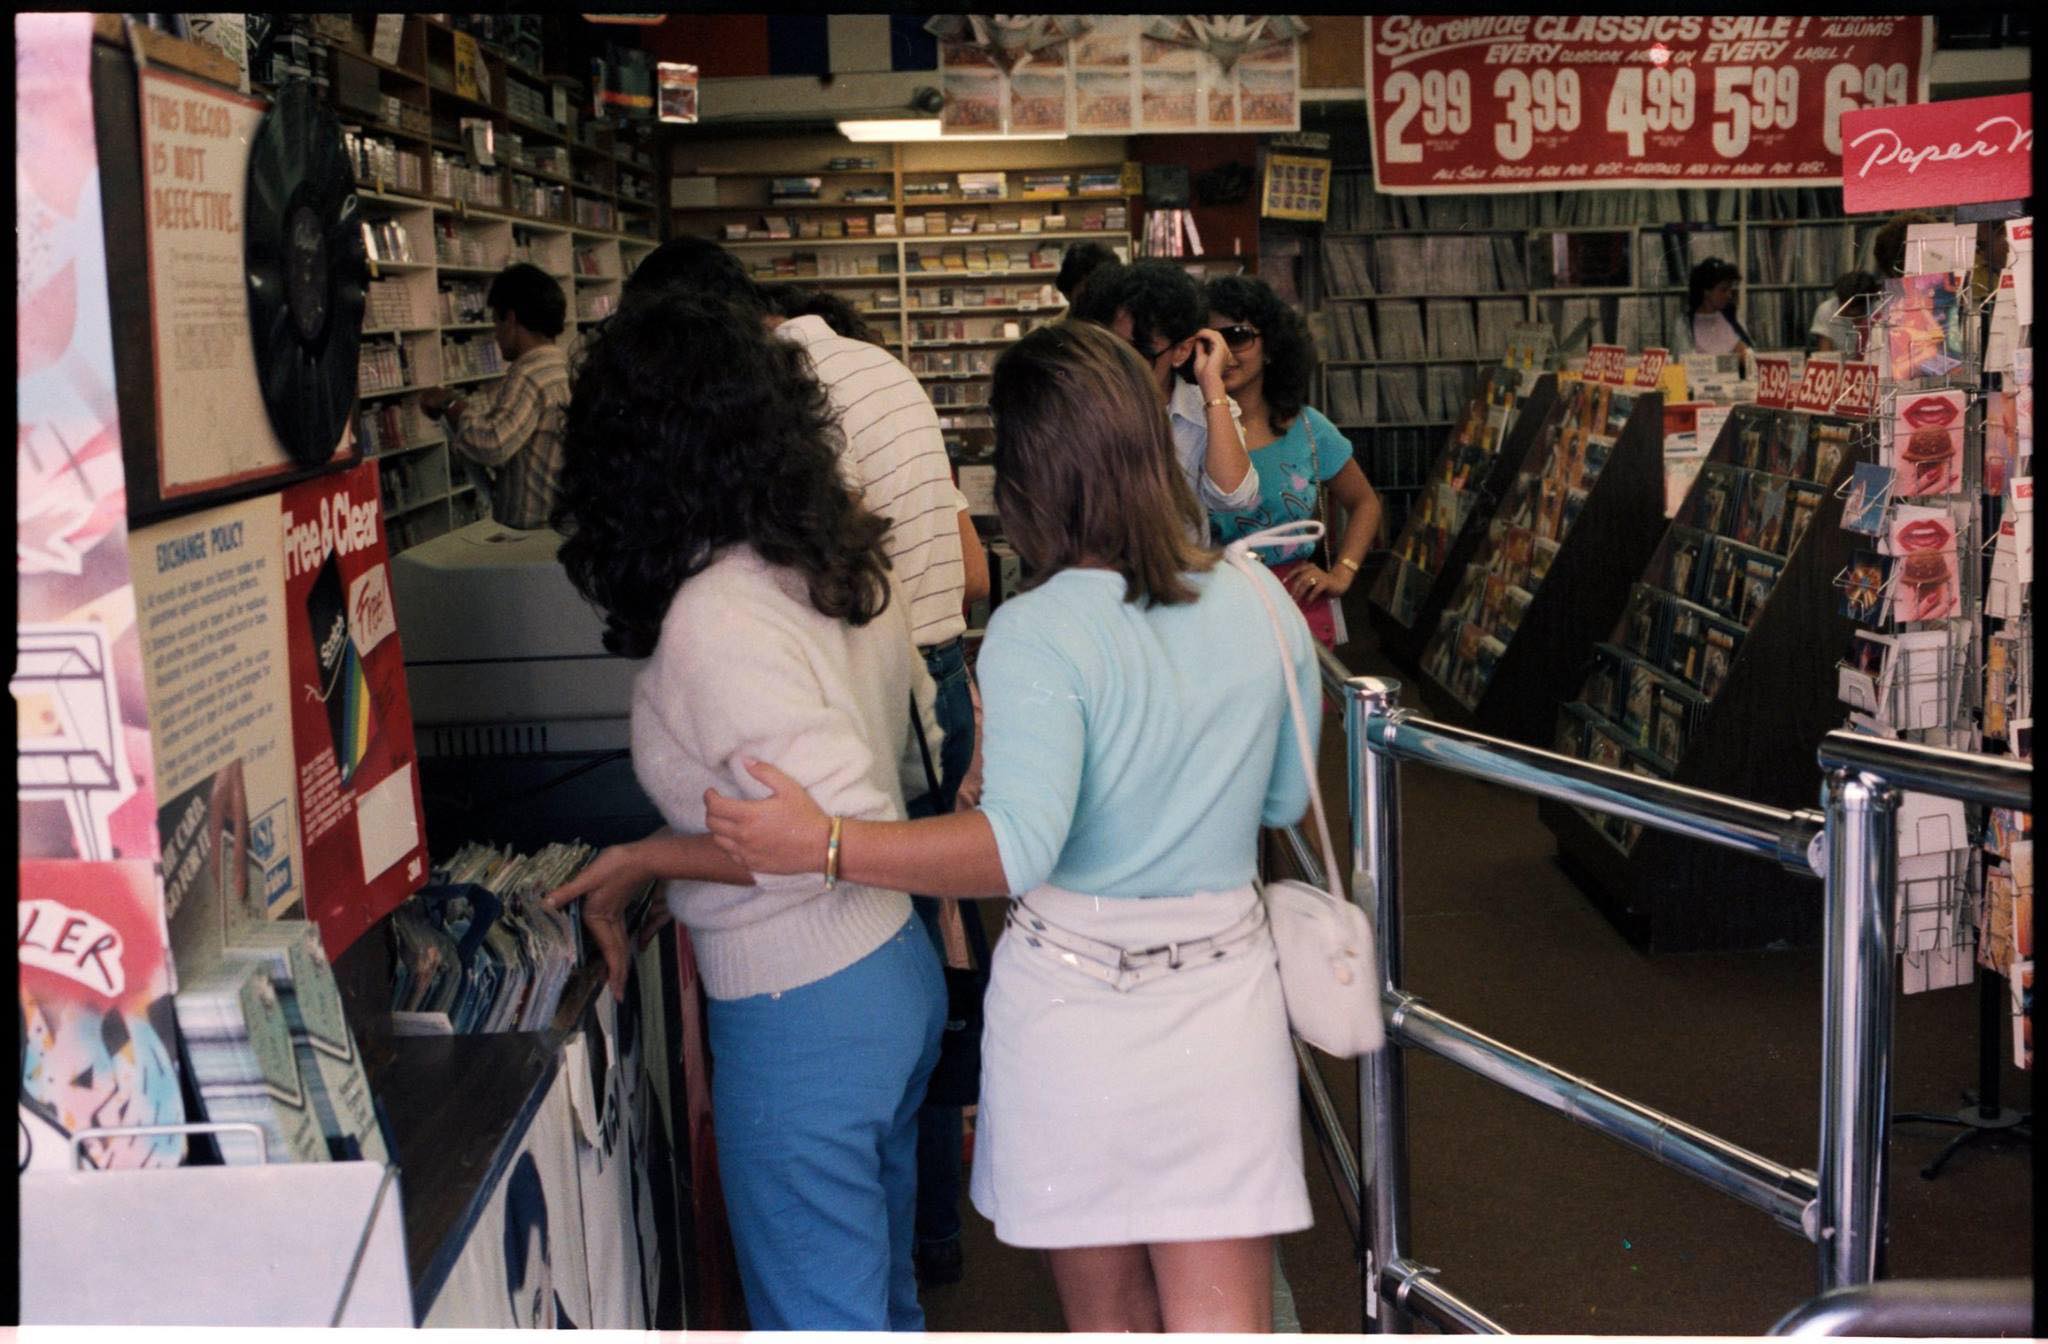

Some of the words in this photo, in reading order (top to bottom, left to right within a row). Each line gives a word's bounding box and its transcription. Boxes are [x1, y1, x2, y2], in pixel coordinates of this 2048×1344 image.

[1533, 16, 1704, 42] CLASSICS
[1822, 23, 1895, 38] ALBUMS
[1484, 43, 1563, 64] EVERY
[1702, 41, 1791, 62] EVERY
[149, 94, 179, 132] THIS
[183, 98, 232, 138] RECORD
[152, 142, 167, 175] IS
[174, 145, 206, 182] NOT
[1850, 128, 1999, 177] Paper
[1760, 364, 1788, 400] 6.99
[1800, 367, 1835, 405] 5.99
[156, 531, 207, 574] EXCHANGE
[211, 520, 243, 556] POLICY
